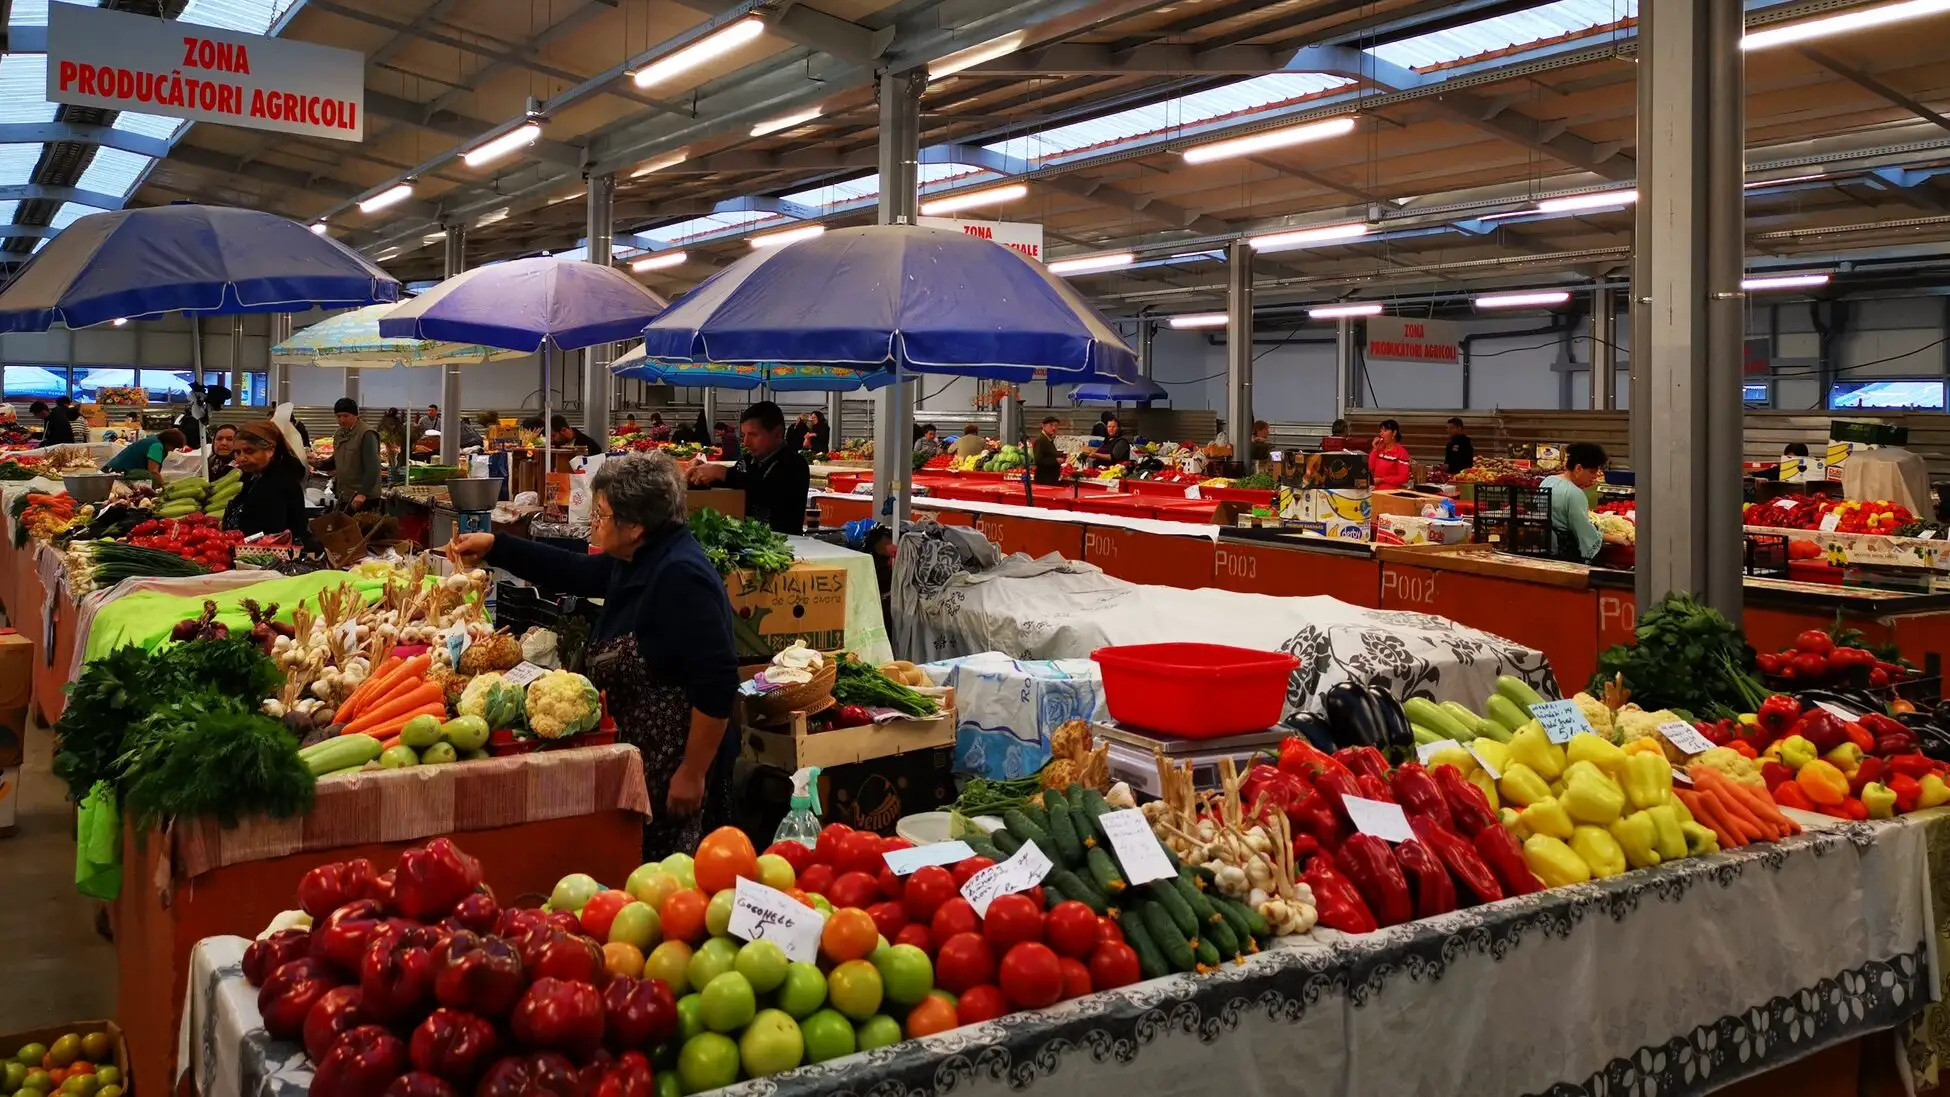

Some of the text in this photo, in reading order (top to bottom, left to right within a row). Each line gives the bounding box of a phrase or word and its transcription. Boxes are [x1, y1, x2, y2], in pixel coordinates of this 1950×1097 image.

[183, 37, 250, 75] ZONA
[250, 89, 356, 130] AGRICOLI
[963, 225, 992, 239] ZONA
[1404, 323, 1424, 338] ZONA
[1424, 344, 1457, 360] AGRICOLI
[1341, 527, 1361, 540] derby
[1428, 529, 1446, 542] Dole
[1214, 550, 1257, 579] P003
[1381, 570, 1436, 603] P002
